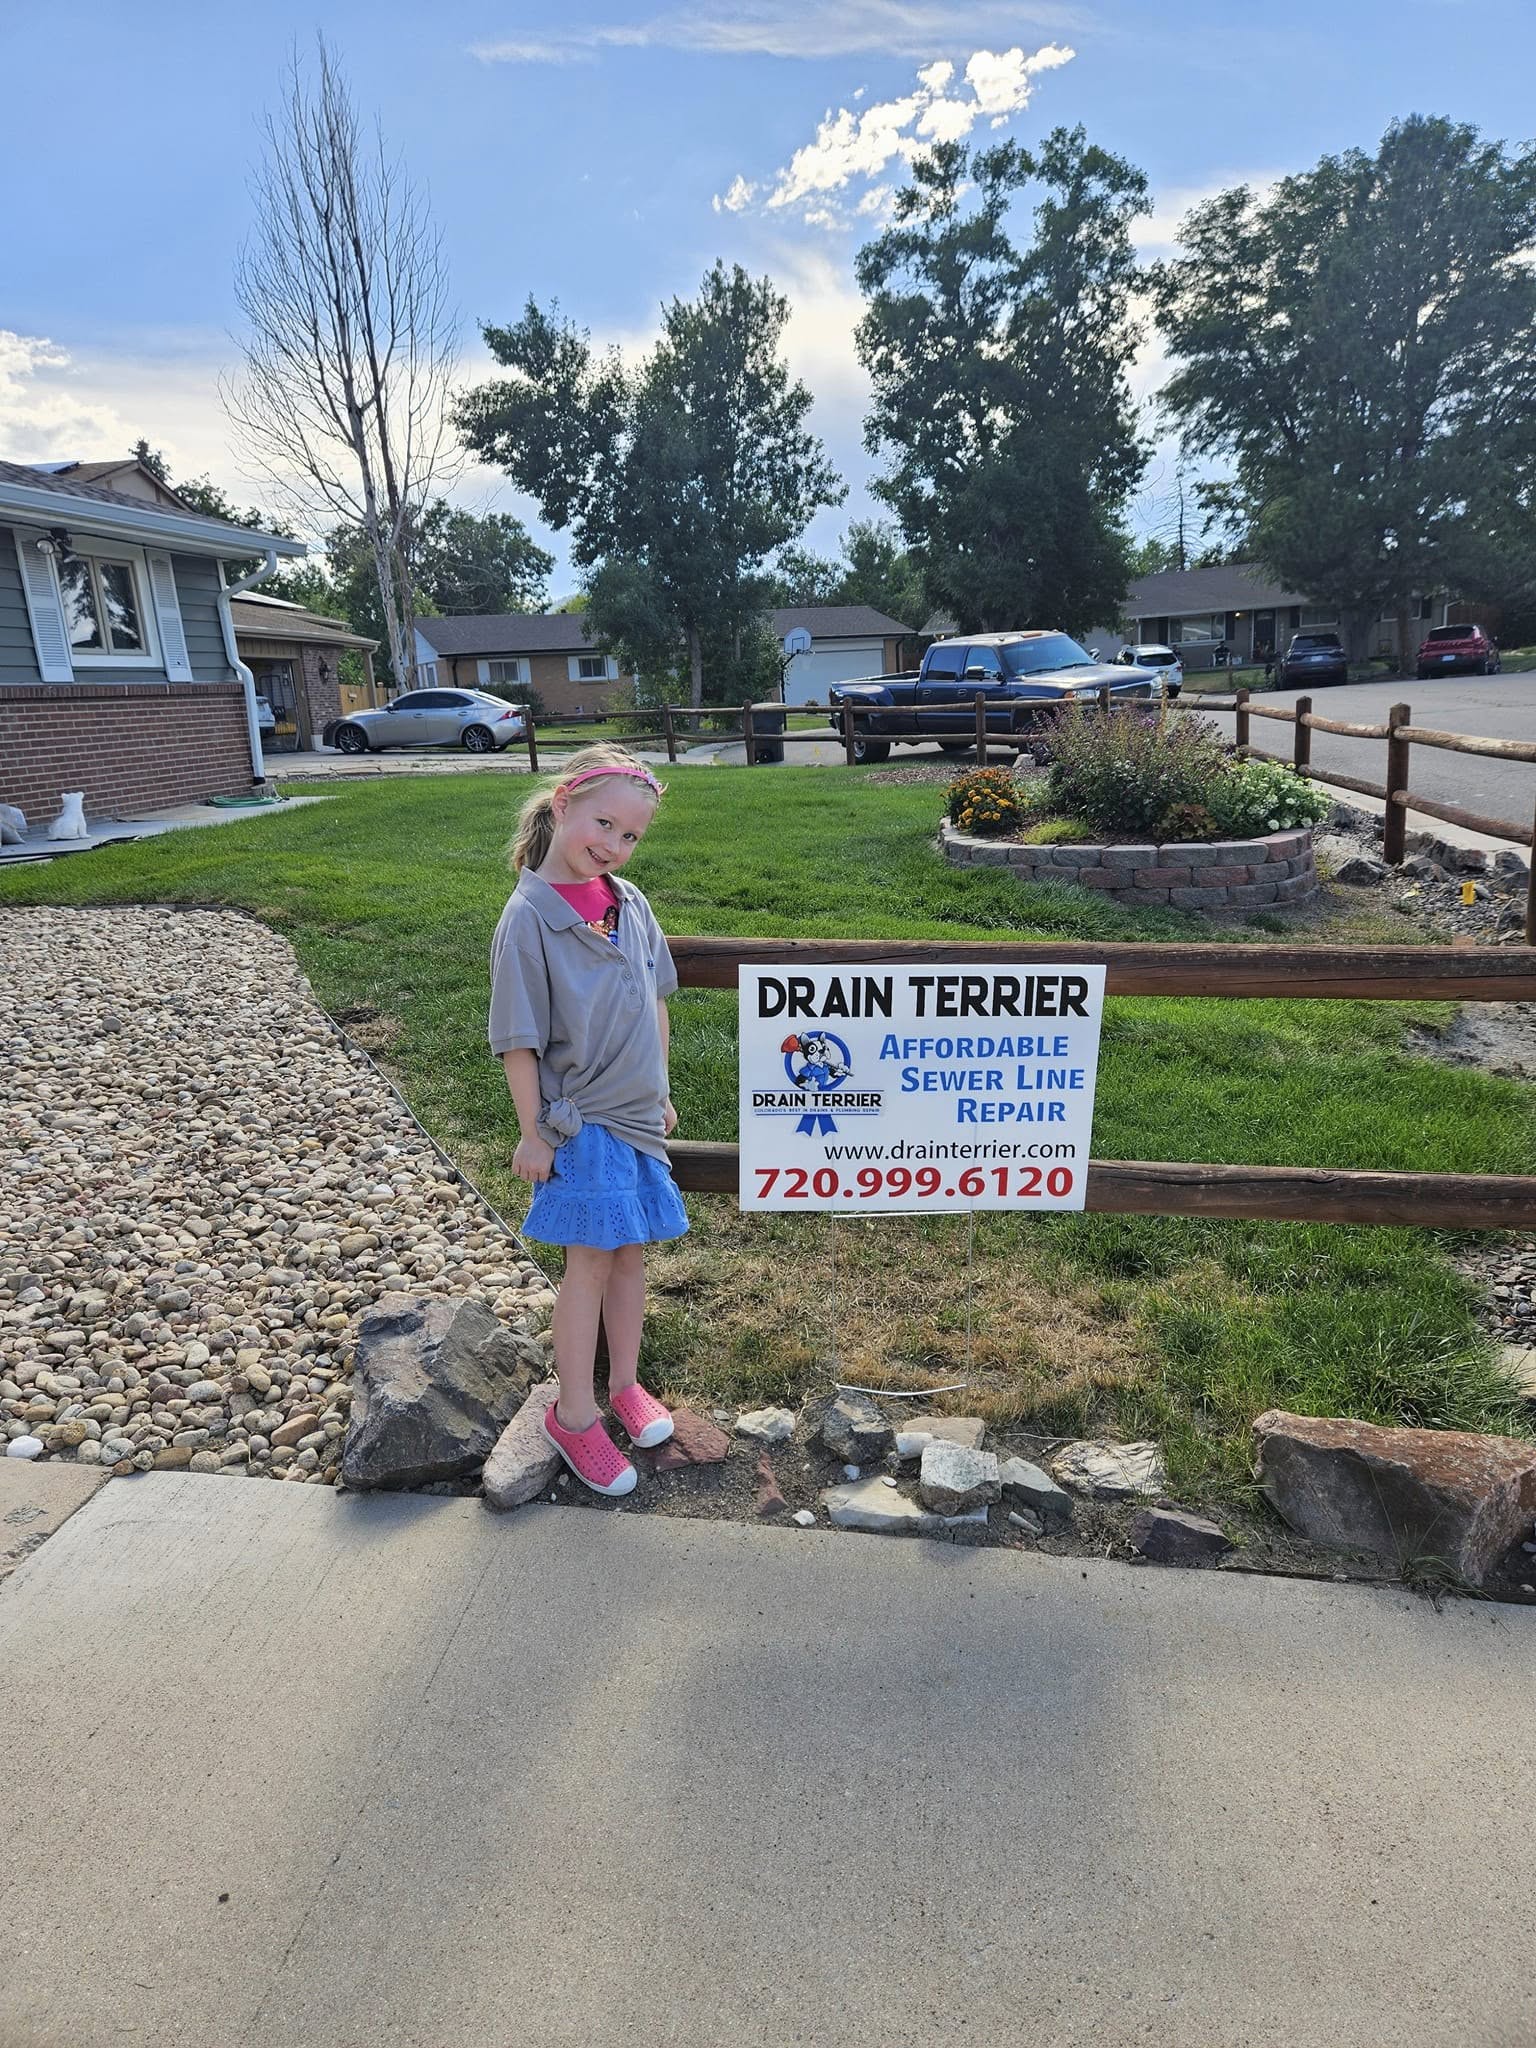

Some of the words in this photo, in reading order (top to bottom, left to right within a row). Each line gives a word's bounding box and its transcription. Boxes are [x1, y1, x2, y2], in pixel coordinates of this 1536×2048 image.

[757, 976, 893, 1018] DRAIN
[908, 975, 1090, 1017] TERRIER
[879, 1033, 1069, 1060] AFFORDABLE
[901, 1066, 1004, 1092] SEWER
[1016, 1064, 1086, 1090] LINE
[753, 1093, 806, 1107] DRAIN
[811, 1093, 882, 1107] TERRIER
[957, 1098, 1067, 1124] REPAIR
[824, 1139, 1076, 1161] www.drainterrier.com
[754, 1166, 1074, 1199] 720.999.6120
